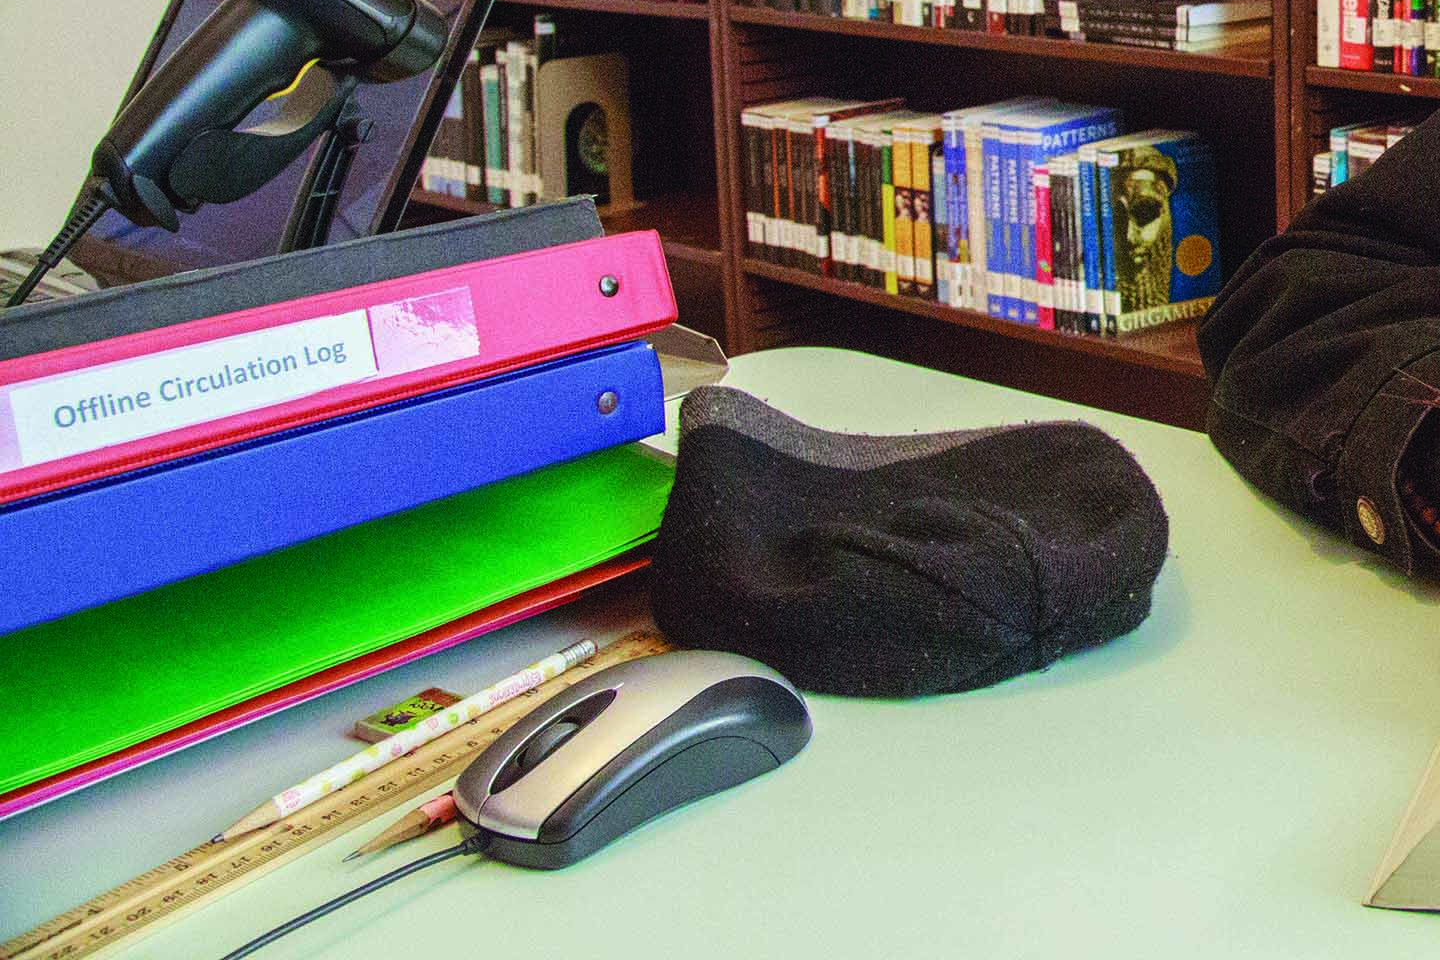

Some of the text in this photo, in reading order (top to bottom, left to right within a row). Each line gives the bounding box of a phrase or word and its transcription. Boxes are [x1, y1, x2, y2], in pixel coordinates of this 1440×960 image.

[991, 155, 1001, 219] PATTERNS
[1008, 159, 1018, 225] PATTERNS
[1119, 302, 1209, 332] GILGAMES
[53, 340, 349, 430] Offline Circulation Log
[432, 752, 453, 766] 10
[377, 781, 398, 794] 12
[351, 794, 371, 807] 13
[321, 808, 343, 821] 14
[291, 823, 313, 837] 15
[261, 839, 283, 854] 16
[231, 855, 252, 870] 17
[196, 871, 219, 887] 18
[162, 888, 185, 904] 19
[125, 905, 152, 922] 20
[88, 924, 115, 940] 21
